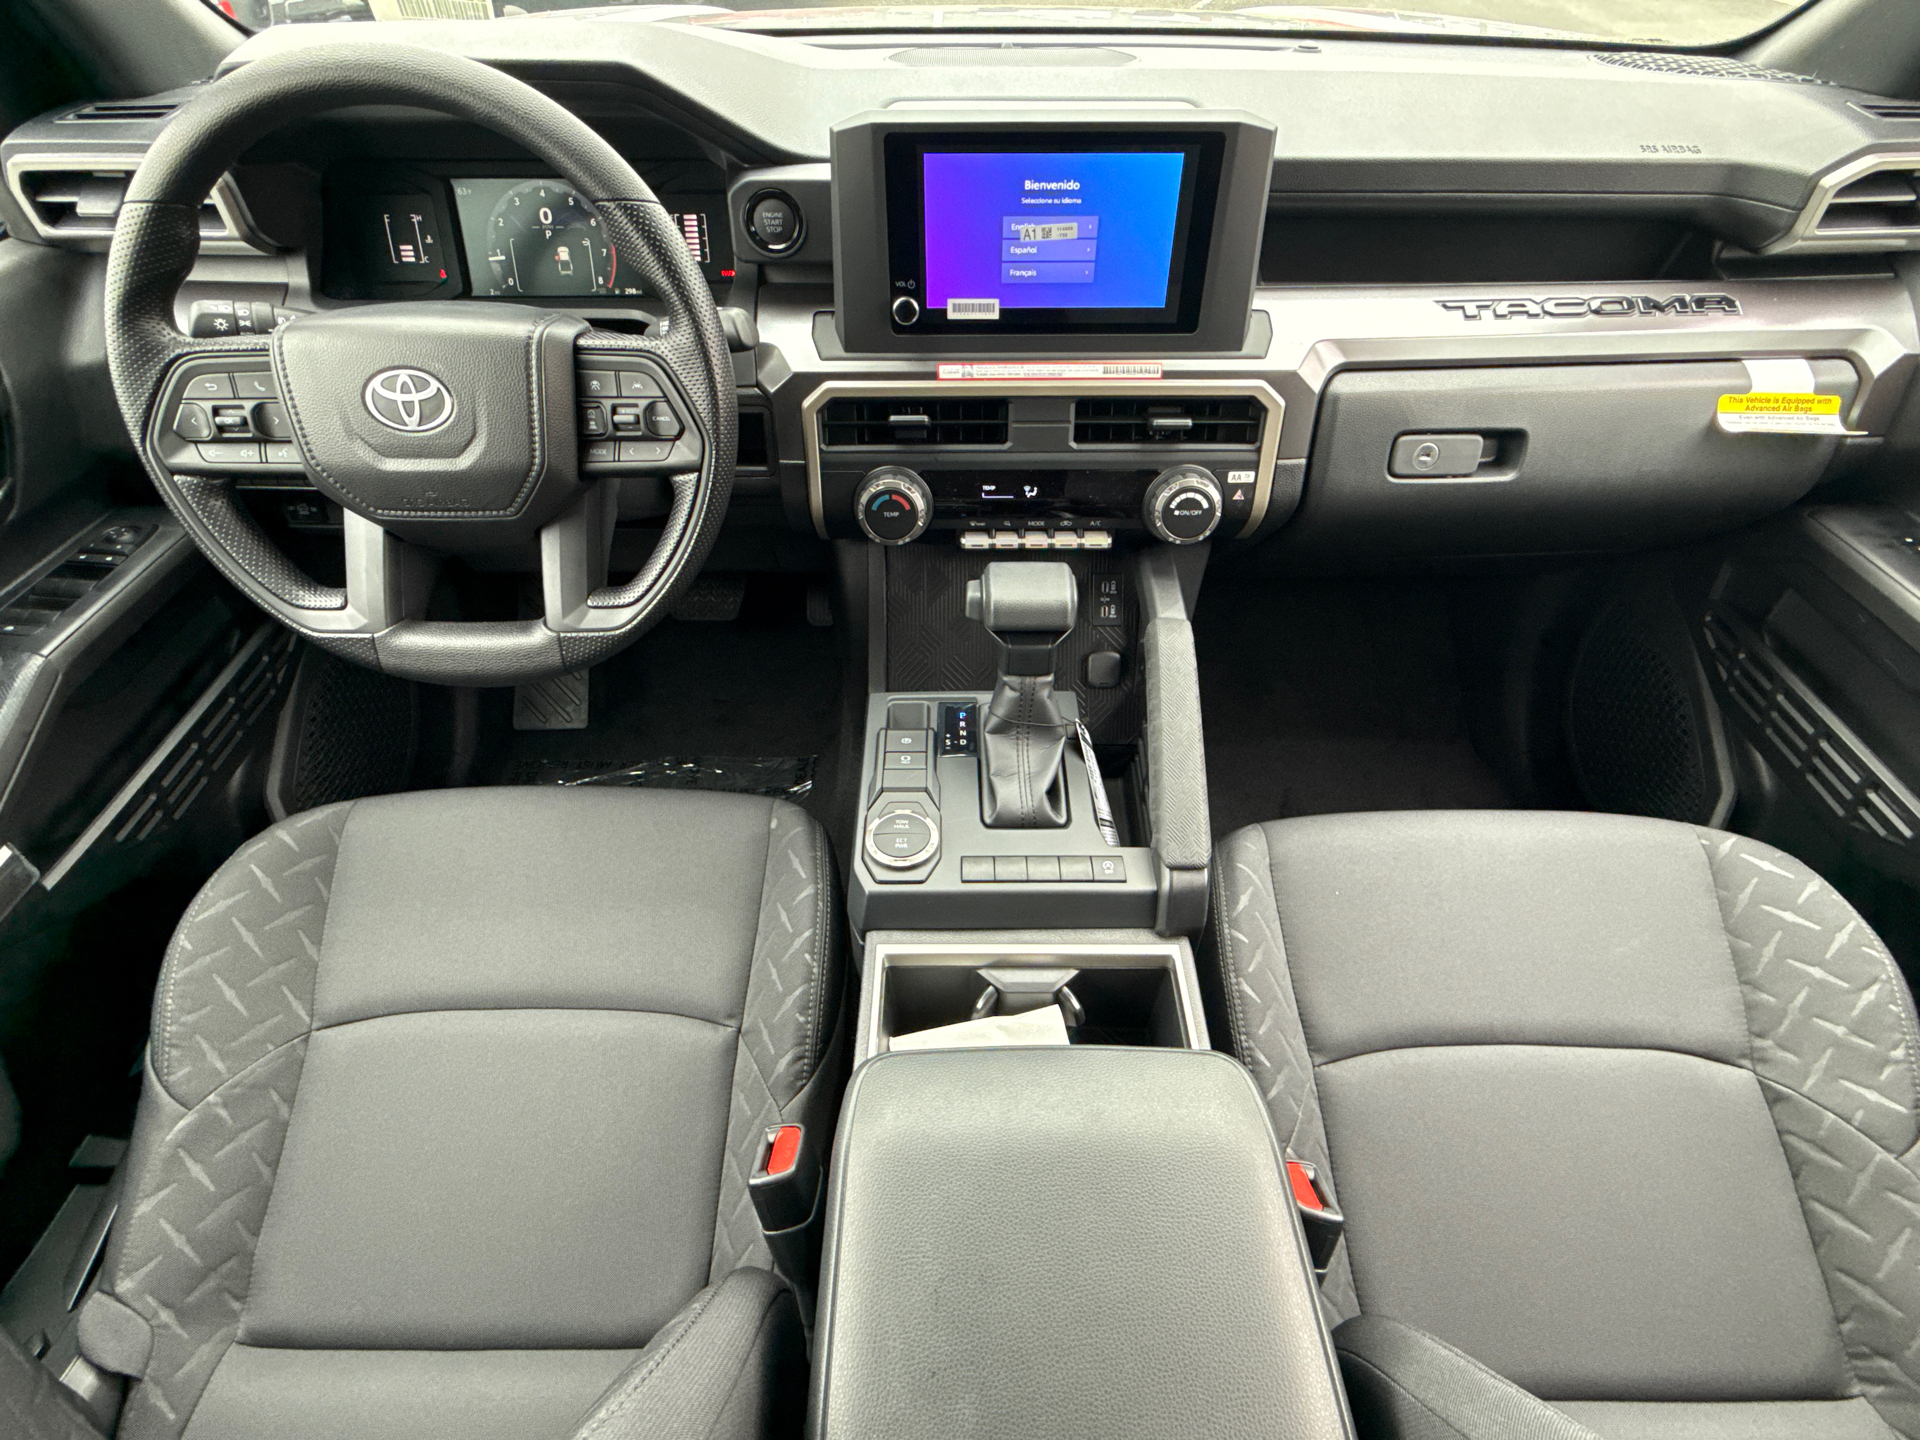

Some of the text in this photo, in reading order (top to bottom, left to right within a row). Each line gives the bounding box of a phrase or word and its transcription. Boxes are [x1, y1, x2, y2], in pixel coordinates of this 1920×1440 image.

[1661, 144, 1703, 155] AIRBAG
[1024, 180, 1080, 190] Bienvenido
[514, 198, 520, 206] 3
[568, 197, 574, 206] 5
[539, 207, 553, 225] 0
[498, 218, 504, 226] 2
[590, 218, 597, 226] 6
[545, 230, 552, 239] P
[1023, 228, 1037, 240] A1
[1010, 246, 1037, 255] Español
[1009, 269, 1037, 278] Français
[508, 278, 514, 286] 0
[598, 276, 604, 284] 8
[1433, 292, 1744, 321] TACOMA
[1728, 396, 1833, 405] This Vehicle is Equipped with
[1745, 404, 1813, 414] Advanced Air Bags
[1231, 474, 1242, 482] AA
[959, 711, 967, 719] P
